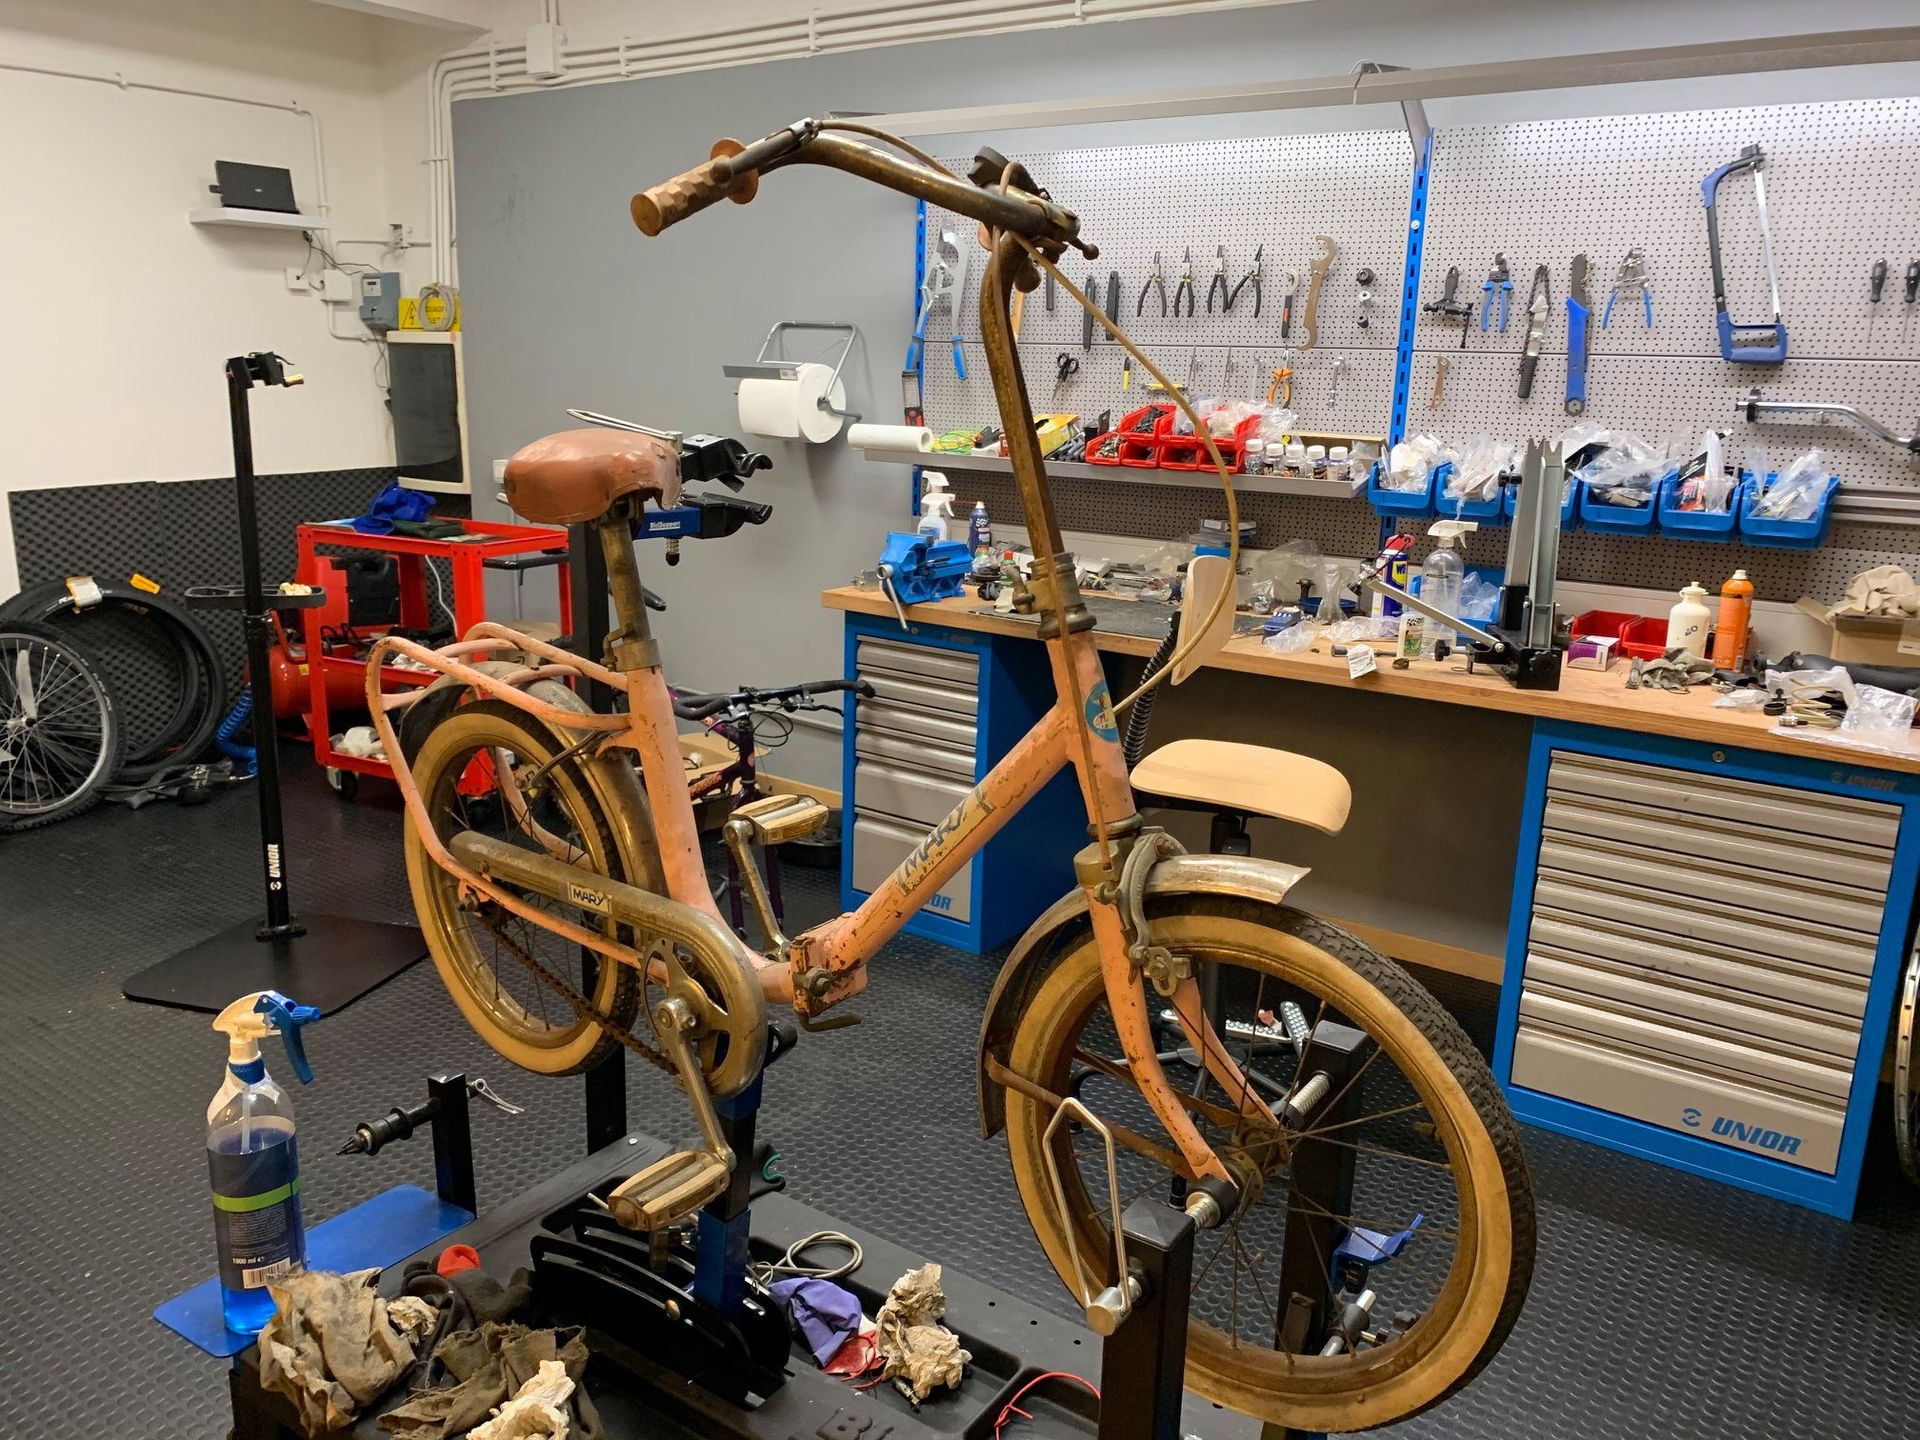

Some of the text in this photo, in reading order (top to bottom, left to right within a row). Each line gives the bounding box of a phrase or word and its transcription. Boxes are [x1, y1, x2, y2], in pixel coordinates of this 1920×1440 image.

[904, 798, 969, 879] MARY
[267, 843, 281, 878] UNIOR
[573, 887, 605, 907] MARY
[1711, 1116, 1802, 1156] UNIOR
